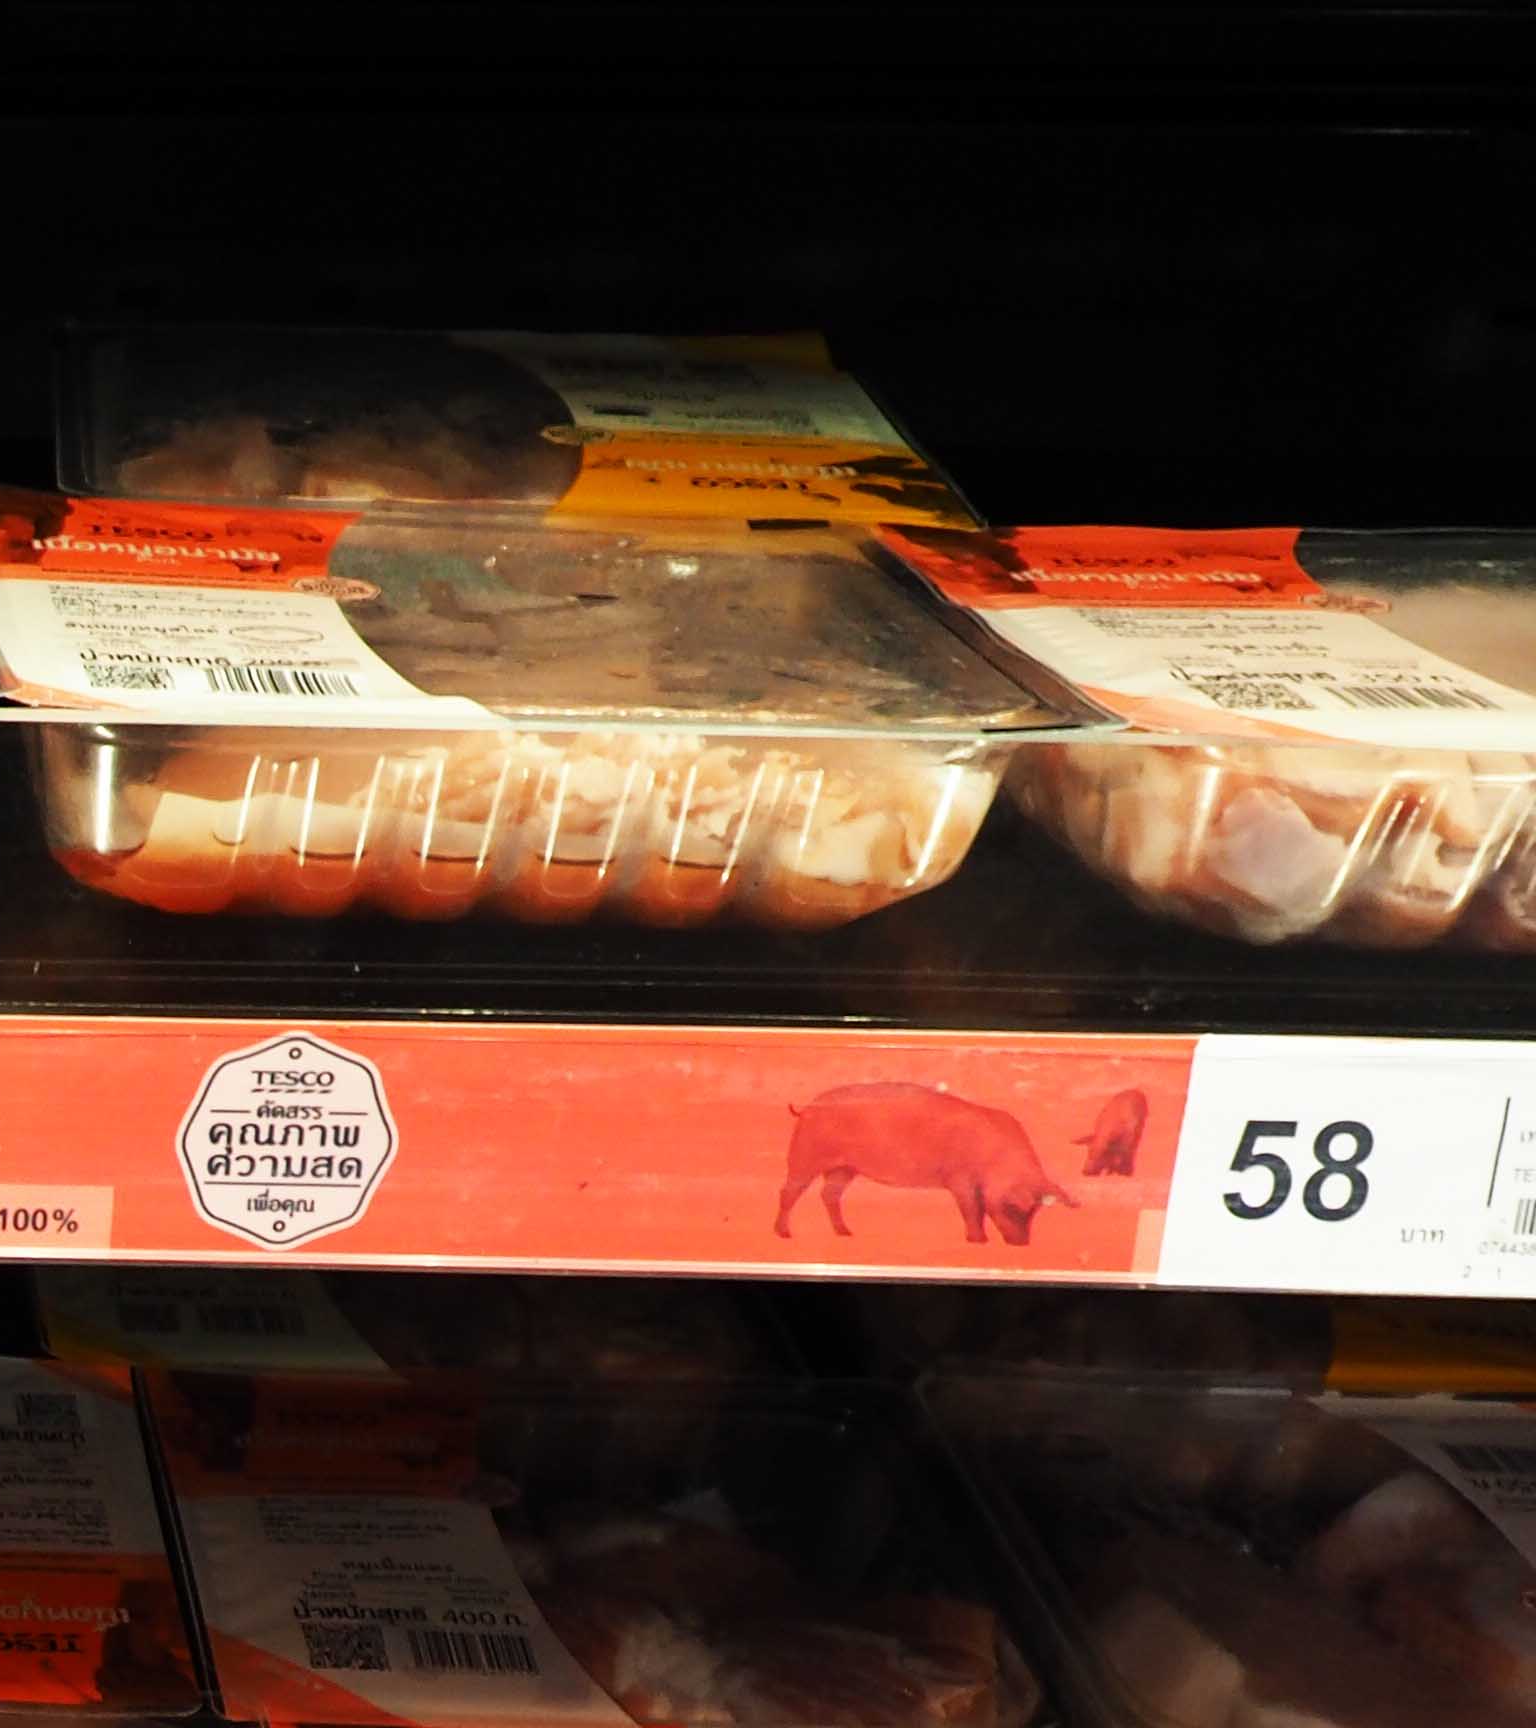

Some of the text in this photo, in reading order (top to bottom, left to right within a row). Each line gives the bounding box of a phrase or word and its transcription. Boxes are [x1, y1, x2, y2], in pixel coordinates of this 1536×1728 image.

[252, 1071, 334, 1086] TESCO
[257, 1100, 323, 1120] คัดสรร
[209, 1123, 360, 1153] คุณภาพ
[207, 1154, 363, 1179] ความสด
[1223, 1120, 1374, 1223] 58
[247, 1189, 315, 1217] เพื่อคุณ
[443, 1609, 497, 1627] 400
